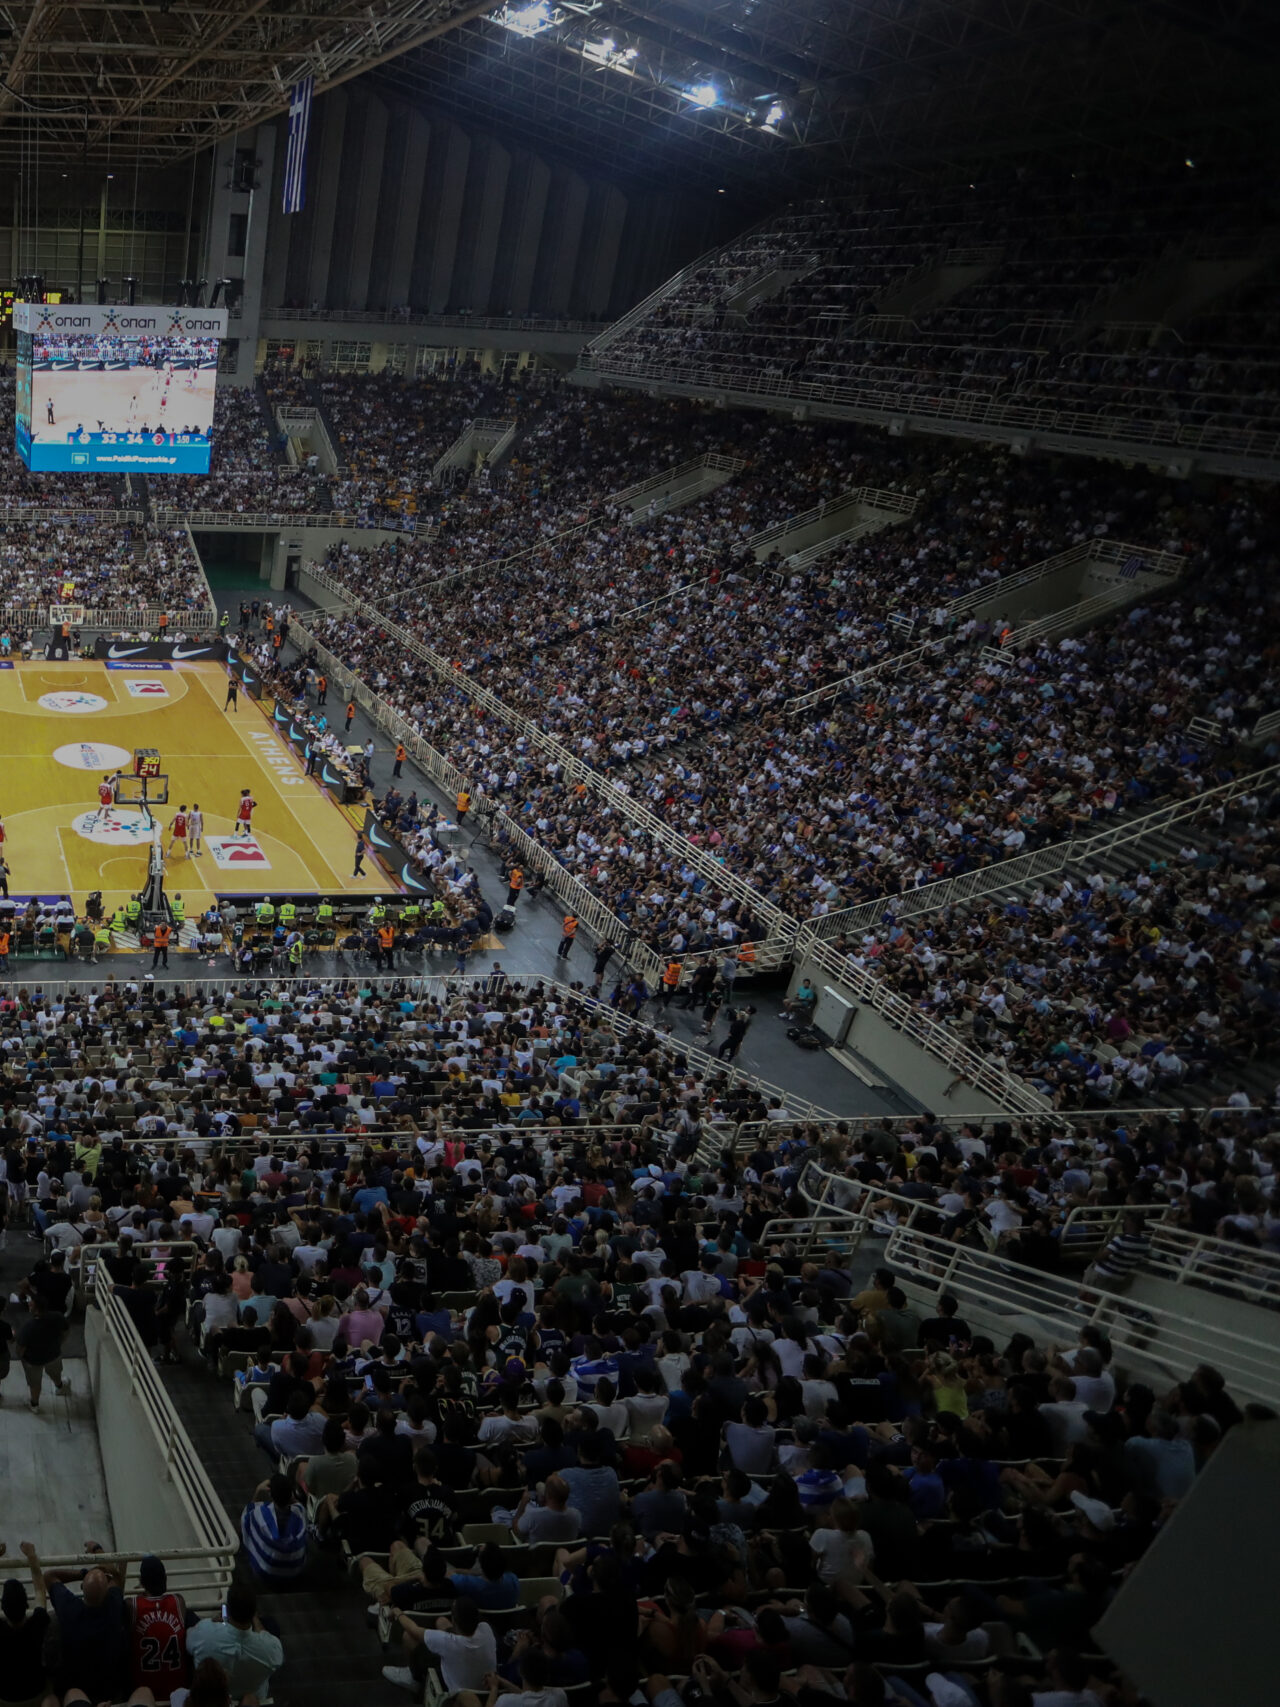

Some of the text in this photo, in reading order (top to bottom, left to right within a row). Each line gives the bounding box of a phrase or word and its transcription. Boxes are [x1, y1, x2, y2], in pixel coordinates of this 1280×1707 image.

[101, 433, 117, 444] 32
[126, 433, 144, 444] 34
[247, 731, 305, 785] ATHENS
[139, 764, 157, 776] 24
[394, 1318, 412, 1333] 12
[415, 1517, 445, 1540] 34
[135, 1610, 182, 1636] MARKKANEN
[140, 1635, 182, 1673] 24
